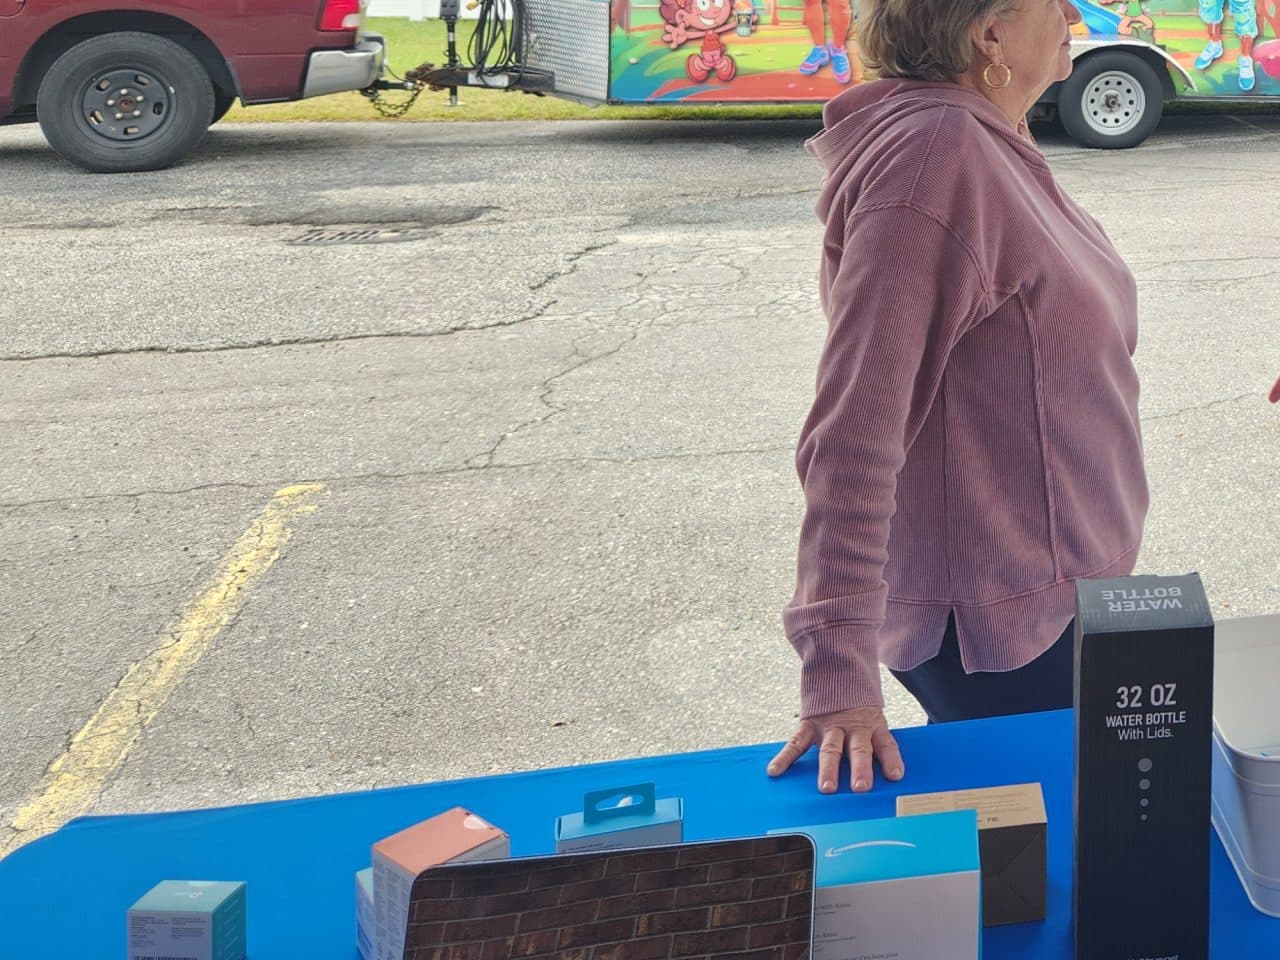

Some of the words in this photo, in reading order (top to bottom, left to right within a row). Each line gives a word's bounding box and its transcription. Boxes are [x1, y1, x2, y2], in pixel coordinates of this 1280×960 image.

[1101, 586, 1182, 600] BOTTLE
[1107, 598, 1183, 612] WATER
[1116, 685, 1142, 709] 32
[1150, 683, 1177, 707] OZ
[1106, 714, 1142, 728] WATER
[1145, 711, 1186, 725] BOTTLE
[1118, 727, 1144, 740] With
[1147, 726, 1174, 739] Lids.
